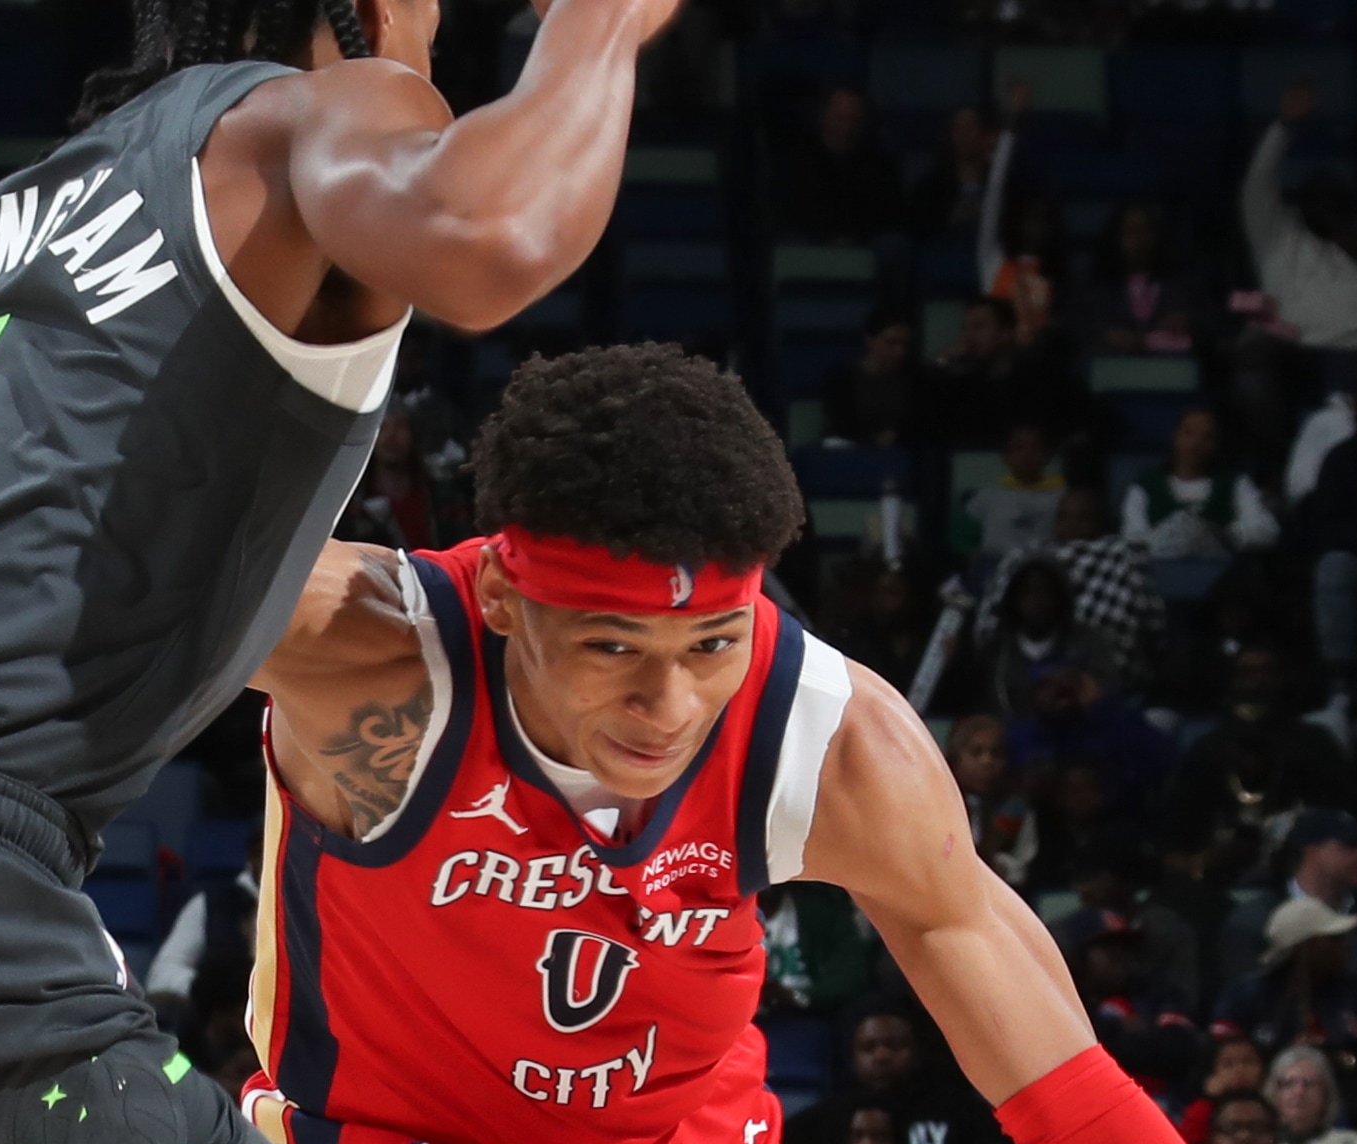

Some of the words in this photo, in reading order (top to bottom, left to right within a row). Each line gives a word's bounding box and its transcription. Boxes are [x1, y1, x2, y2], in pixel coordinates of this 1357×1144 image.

[642, 842, 733, 882] NEWAGE
[645, 863, 719, 895] PRODUCTS
[431, 844, 732, 947] CRESCNT
[512, 1024, 657, 1108] CITY
